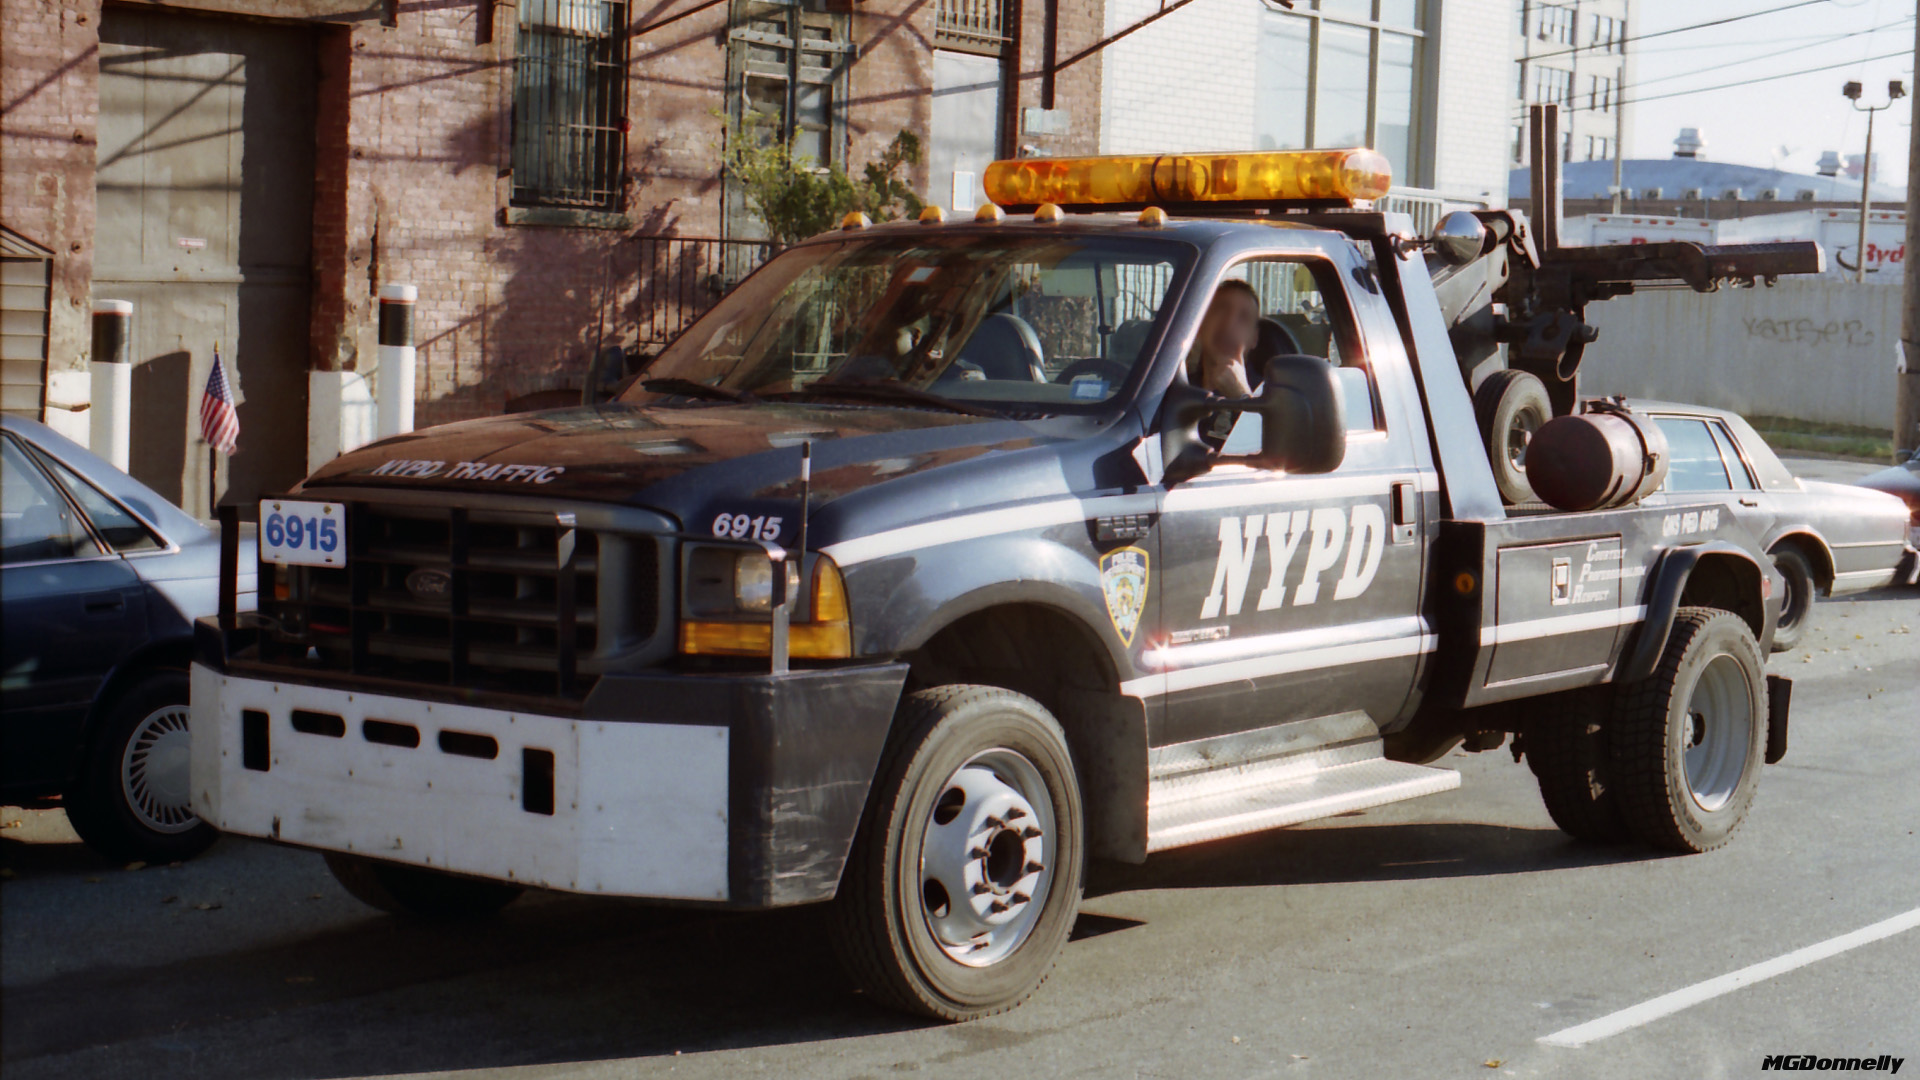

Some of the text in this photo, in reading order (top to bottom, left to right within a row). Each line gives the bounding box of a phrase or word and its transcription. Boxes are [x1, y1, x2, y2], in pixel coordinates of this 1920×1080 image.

[1866, 243, 1906, 267] Ryd
[371, 459, 565, 484] NYPD TRAFFIC
[266, 513, 338, 552] 6915
[712, 512, 783, 541] 6915
[1200, 504, 1386, 620] NYPD
